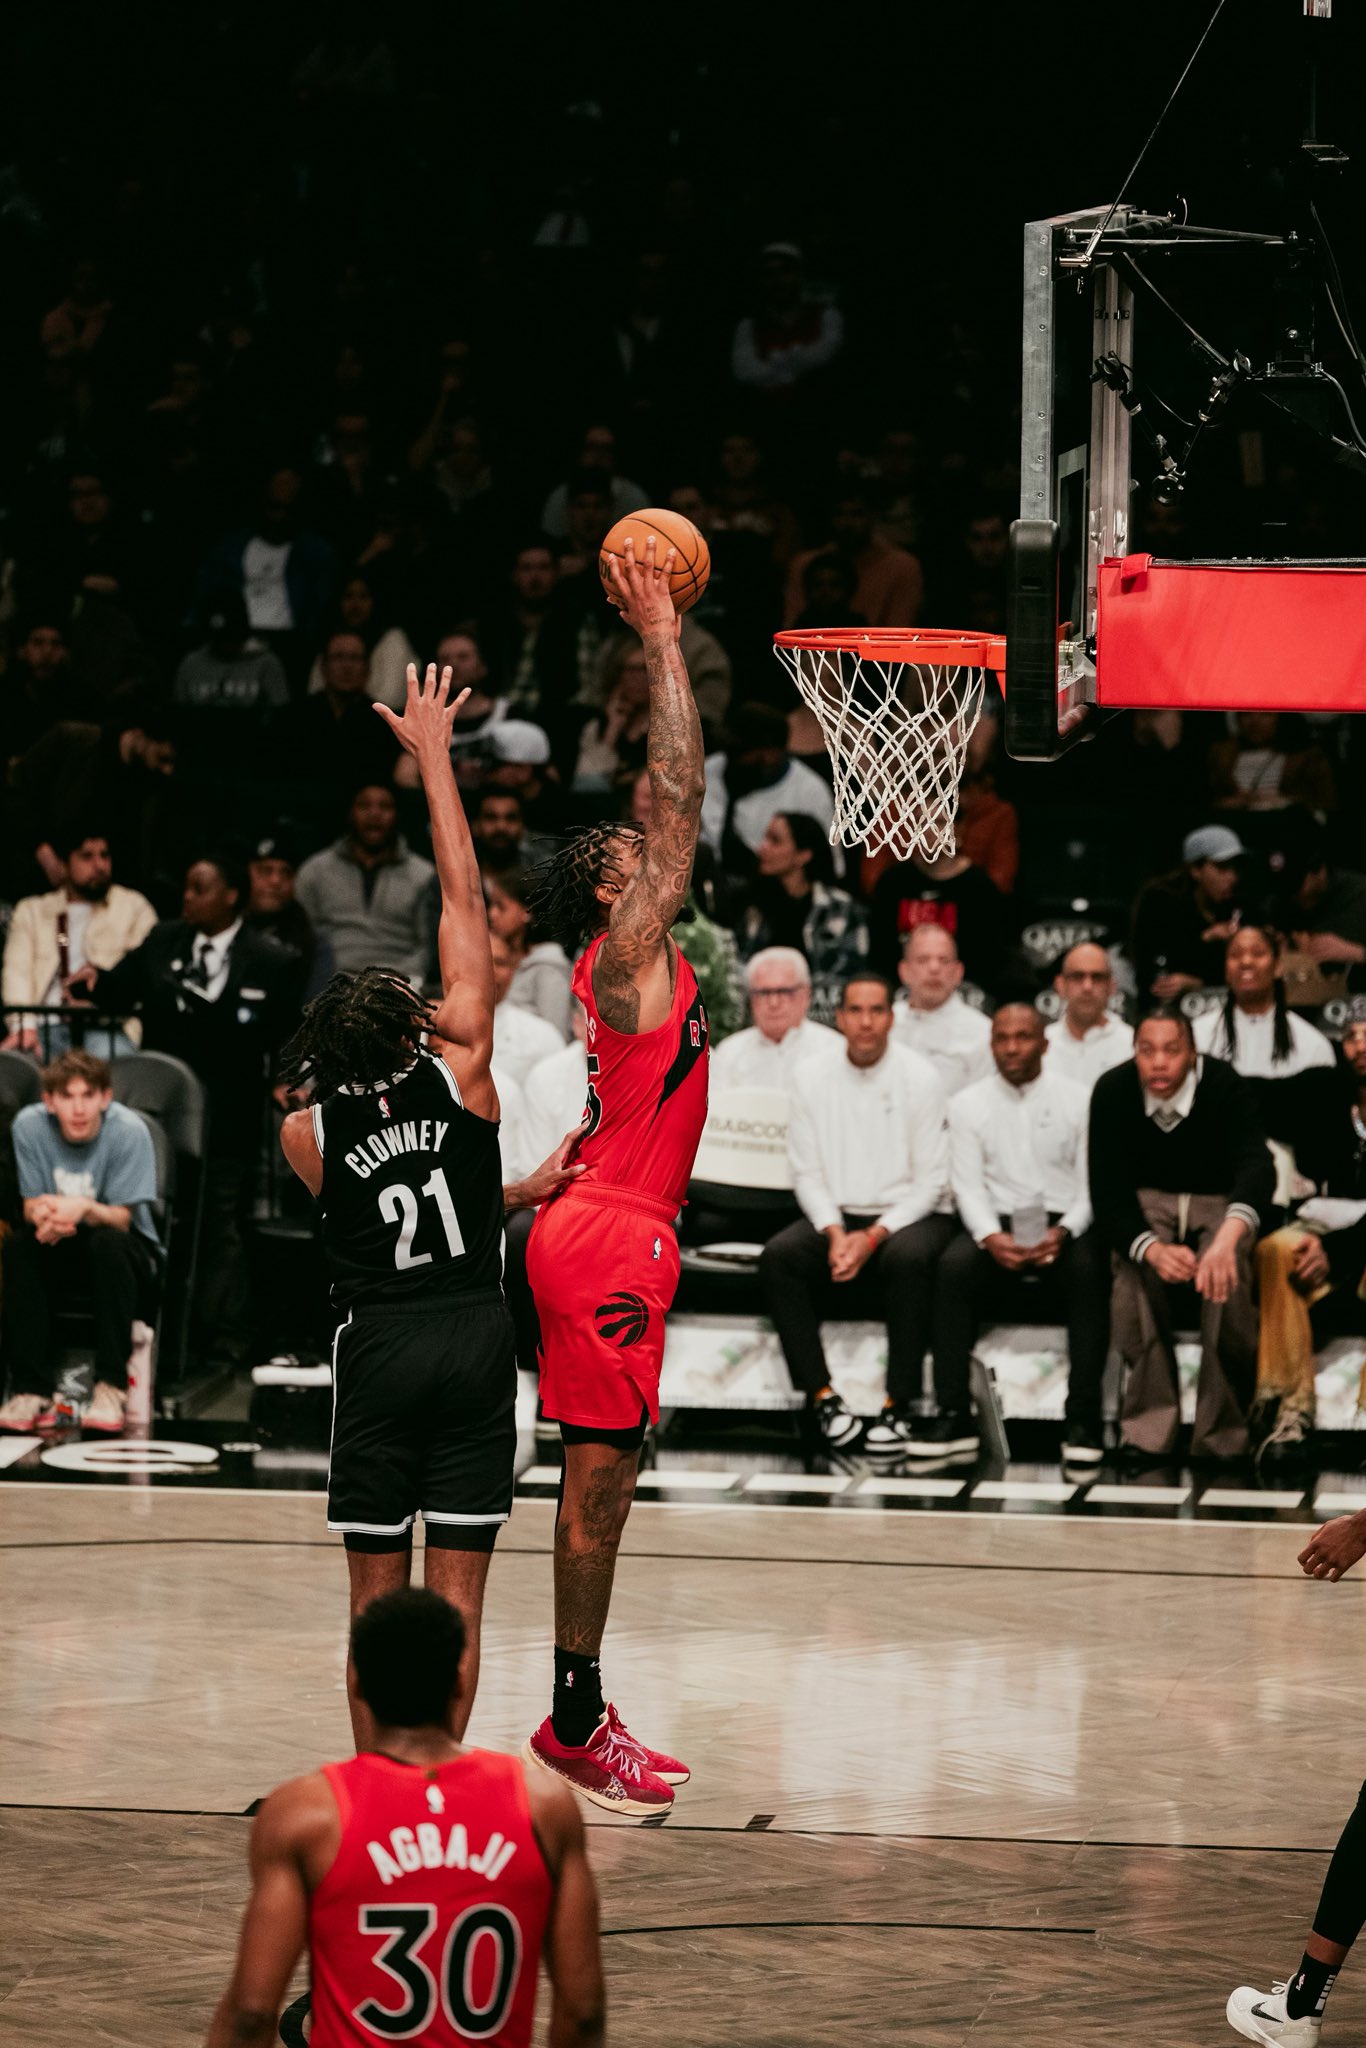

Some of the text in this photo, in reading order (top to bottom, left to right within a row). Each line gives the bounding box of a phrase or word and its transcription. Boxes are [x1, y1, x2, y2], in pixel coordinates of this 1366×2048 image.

[344, 1119, 449, 1179] CLOWNEY
[377, 1167, 466, 1270] 21
[366, 1822, 518, 1886] AGBAJI
[351, 1902, 524, 2041] 30
